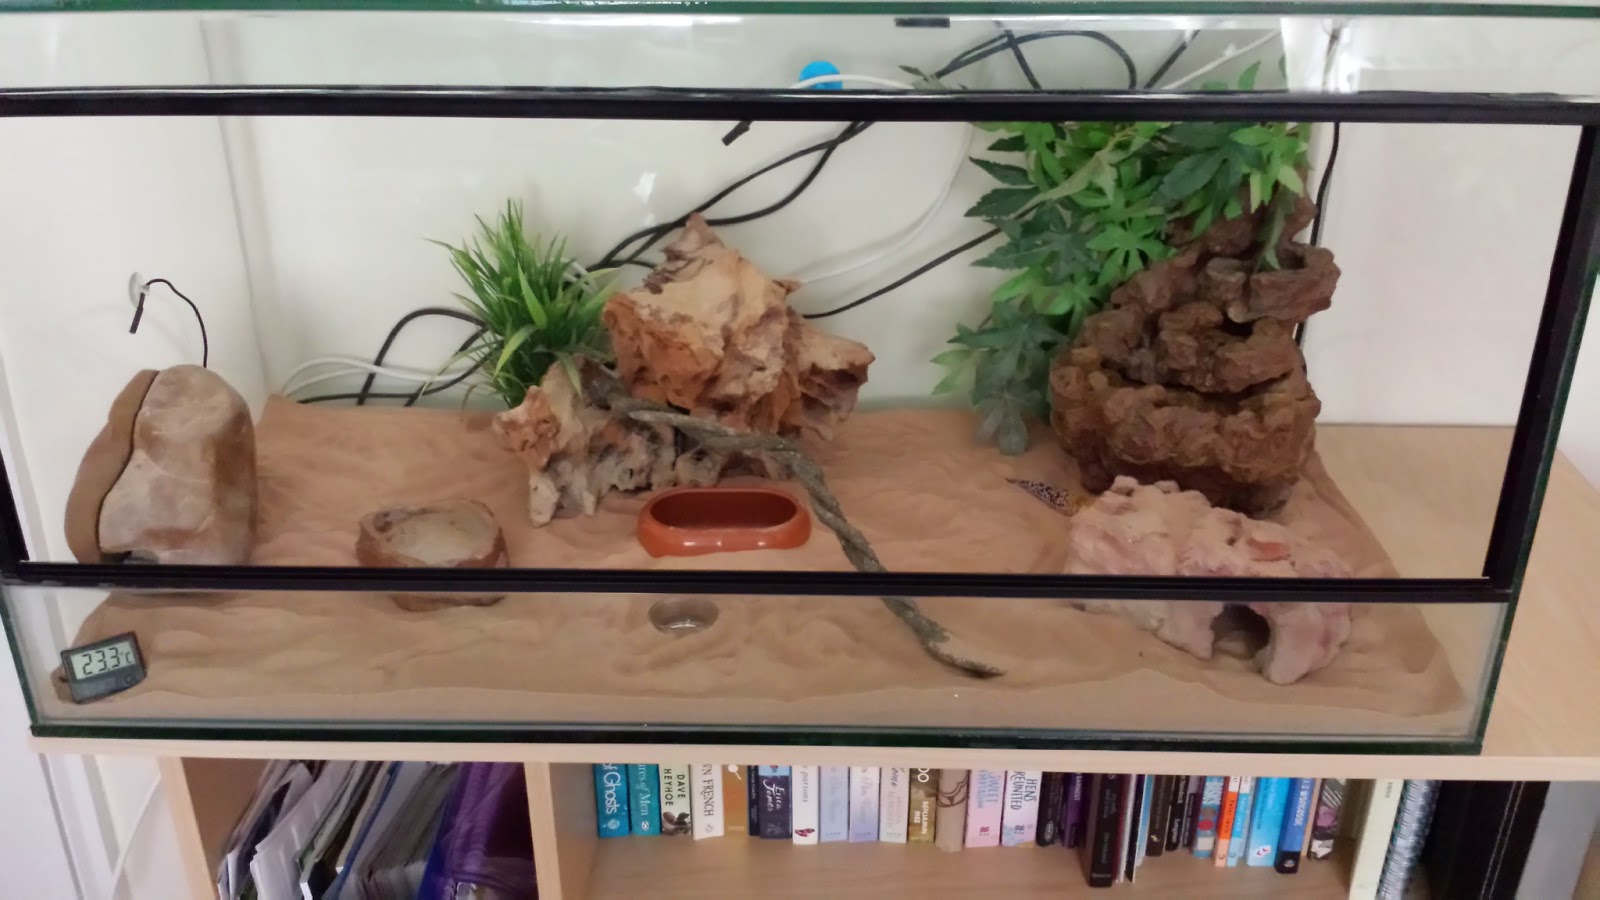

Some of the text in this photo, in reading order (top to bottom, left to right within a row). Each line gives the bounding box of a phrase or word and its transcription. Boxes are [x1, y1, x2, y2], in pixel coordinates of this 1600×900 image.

[603, 771, 621, 814] Ghosts
[664, 768, 686, 806] DAVE HEYHOE
[700, 779, 714, 817] FRENCH
[763, 780, 776, 811] James
[775, 786, 785, 810] Erica
[1010, 771, 1025, 810] REUNITED
[1023, 778, 1038, 802] HENS
[640, 793, 651, 816] Men
[921, 801, 929, 834] BENJAMIN
